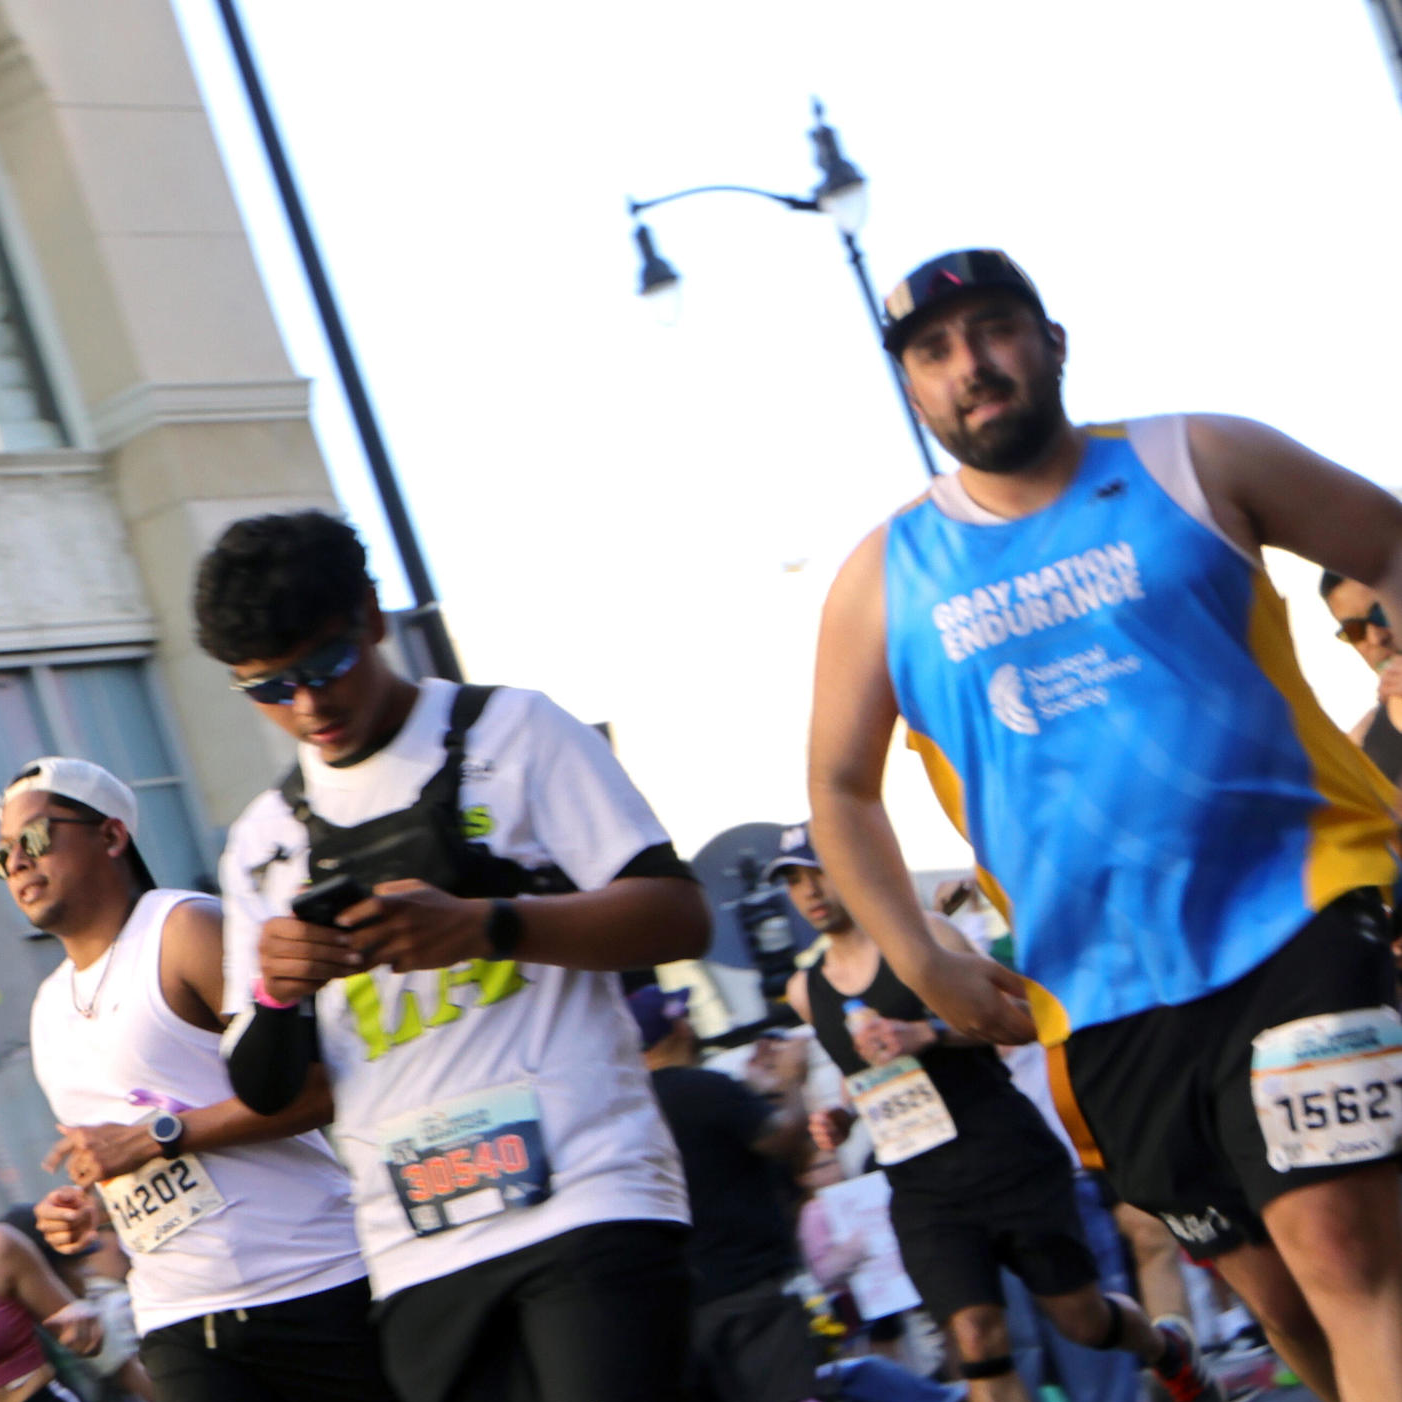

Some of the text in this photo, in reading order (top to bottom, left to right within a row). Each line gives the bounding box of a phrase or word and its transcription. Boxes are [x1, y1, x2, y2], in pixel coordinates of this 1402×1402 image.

[1013, 541, 1137, 601] NATION
[940, 570, 1146, 664] ENDURANCE
[114, 1160, 198, 1229] 14202
[400, 1134, 529, 1203] 30540
